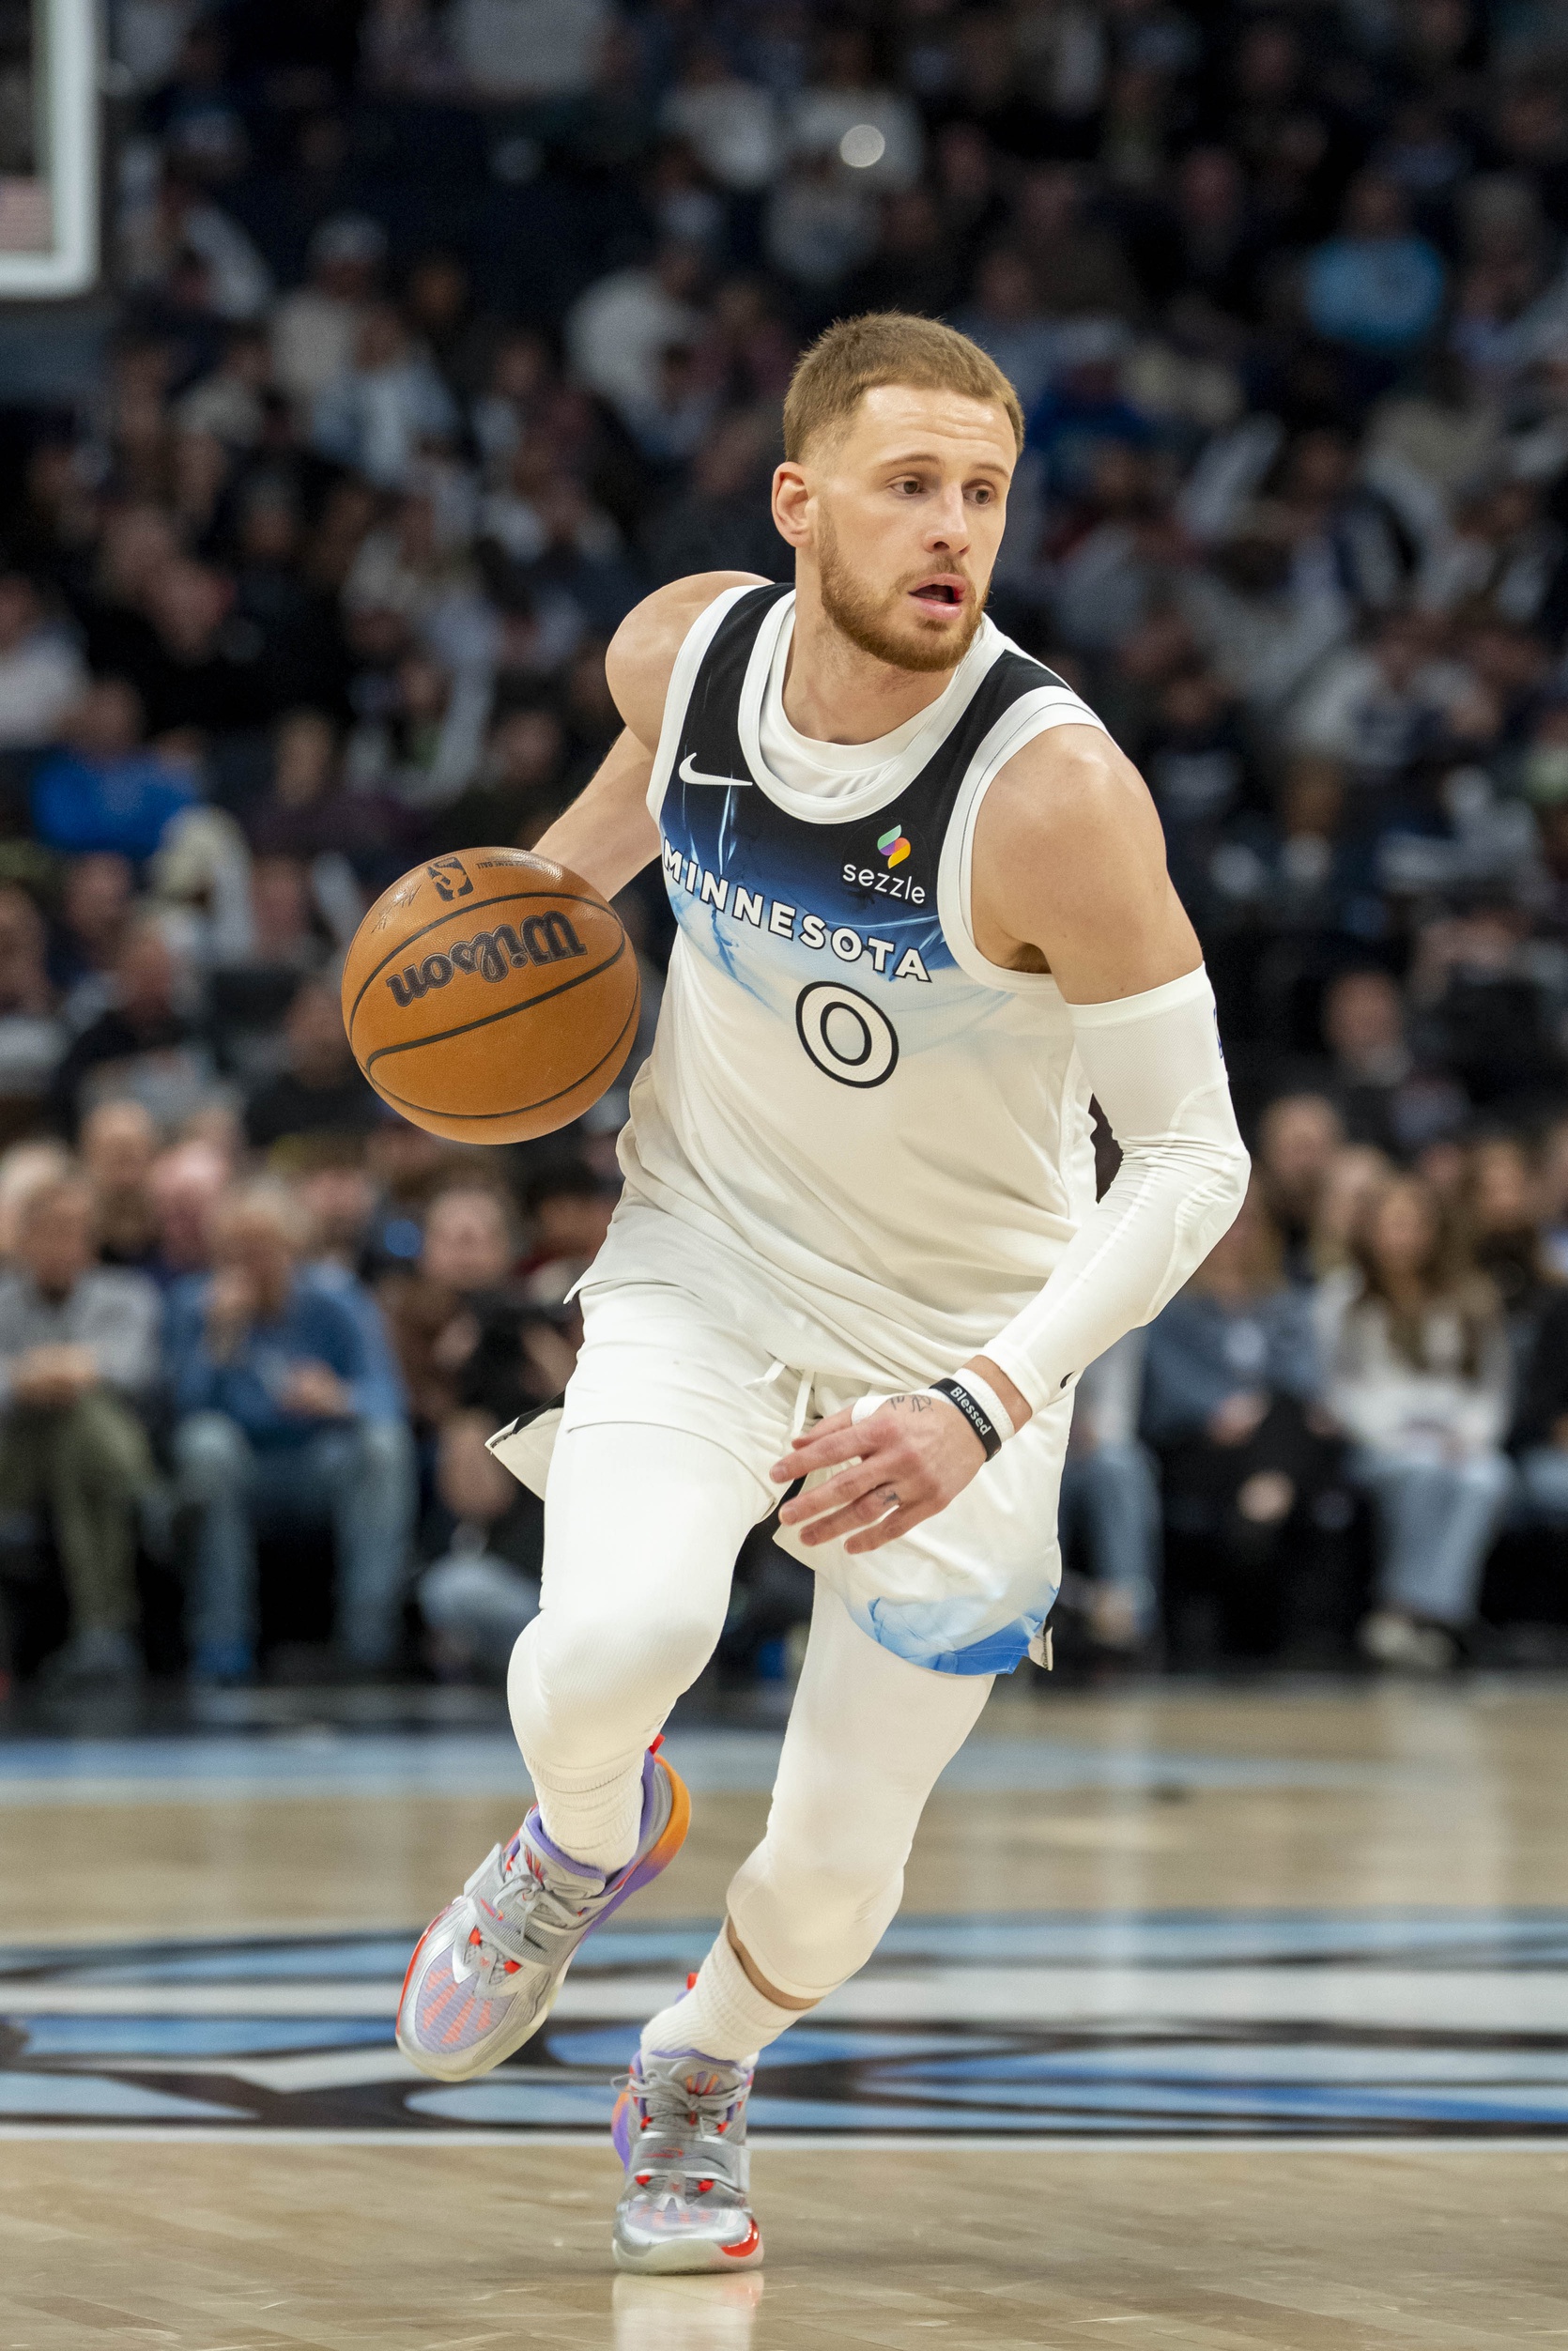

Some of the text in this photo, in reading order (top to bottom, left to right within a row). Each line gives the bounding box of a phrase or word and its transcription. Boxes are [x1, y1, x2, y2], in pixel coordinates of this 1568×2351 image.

[662, 837, 932, 984] MINNESOTA
[842, 862, 925, 904] sezzle
[385, 910, 589, 1007] Wilson
[795, 980, 899, 1089] 0
[949, 1386, 992, 1436] Blessed
